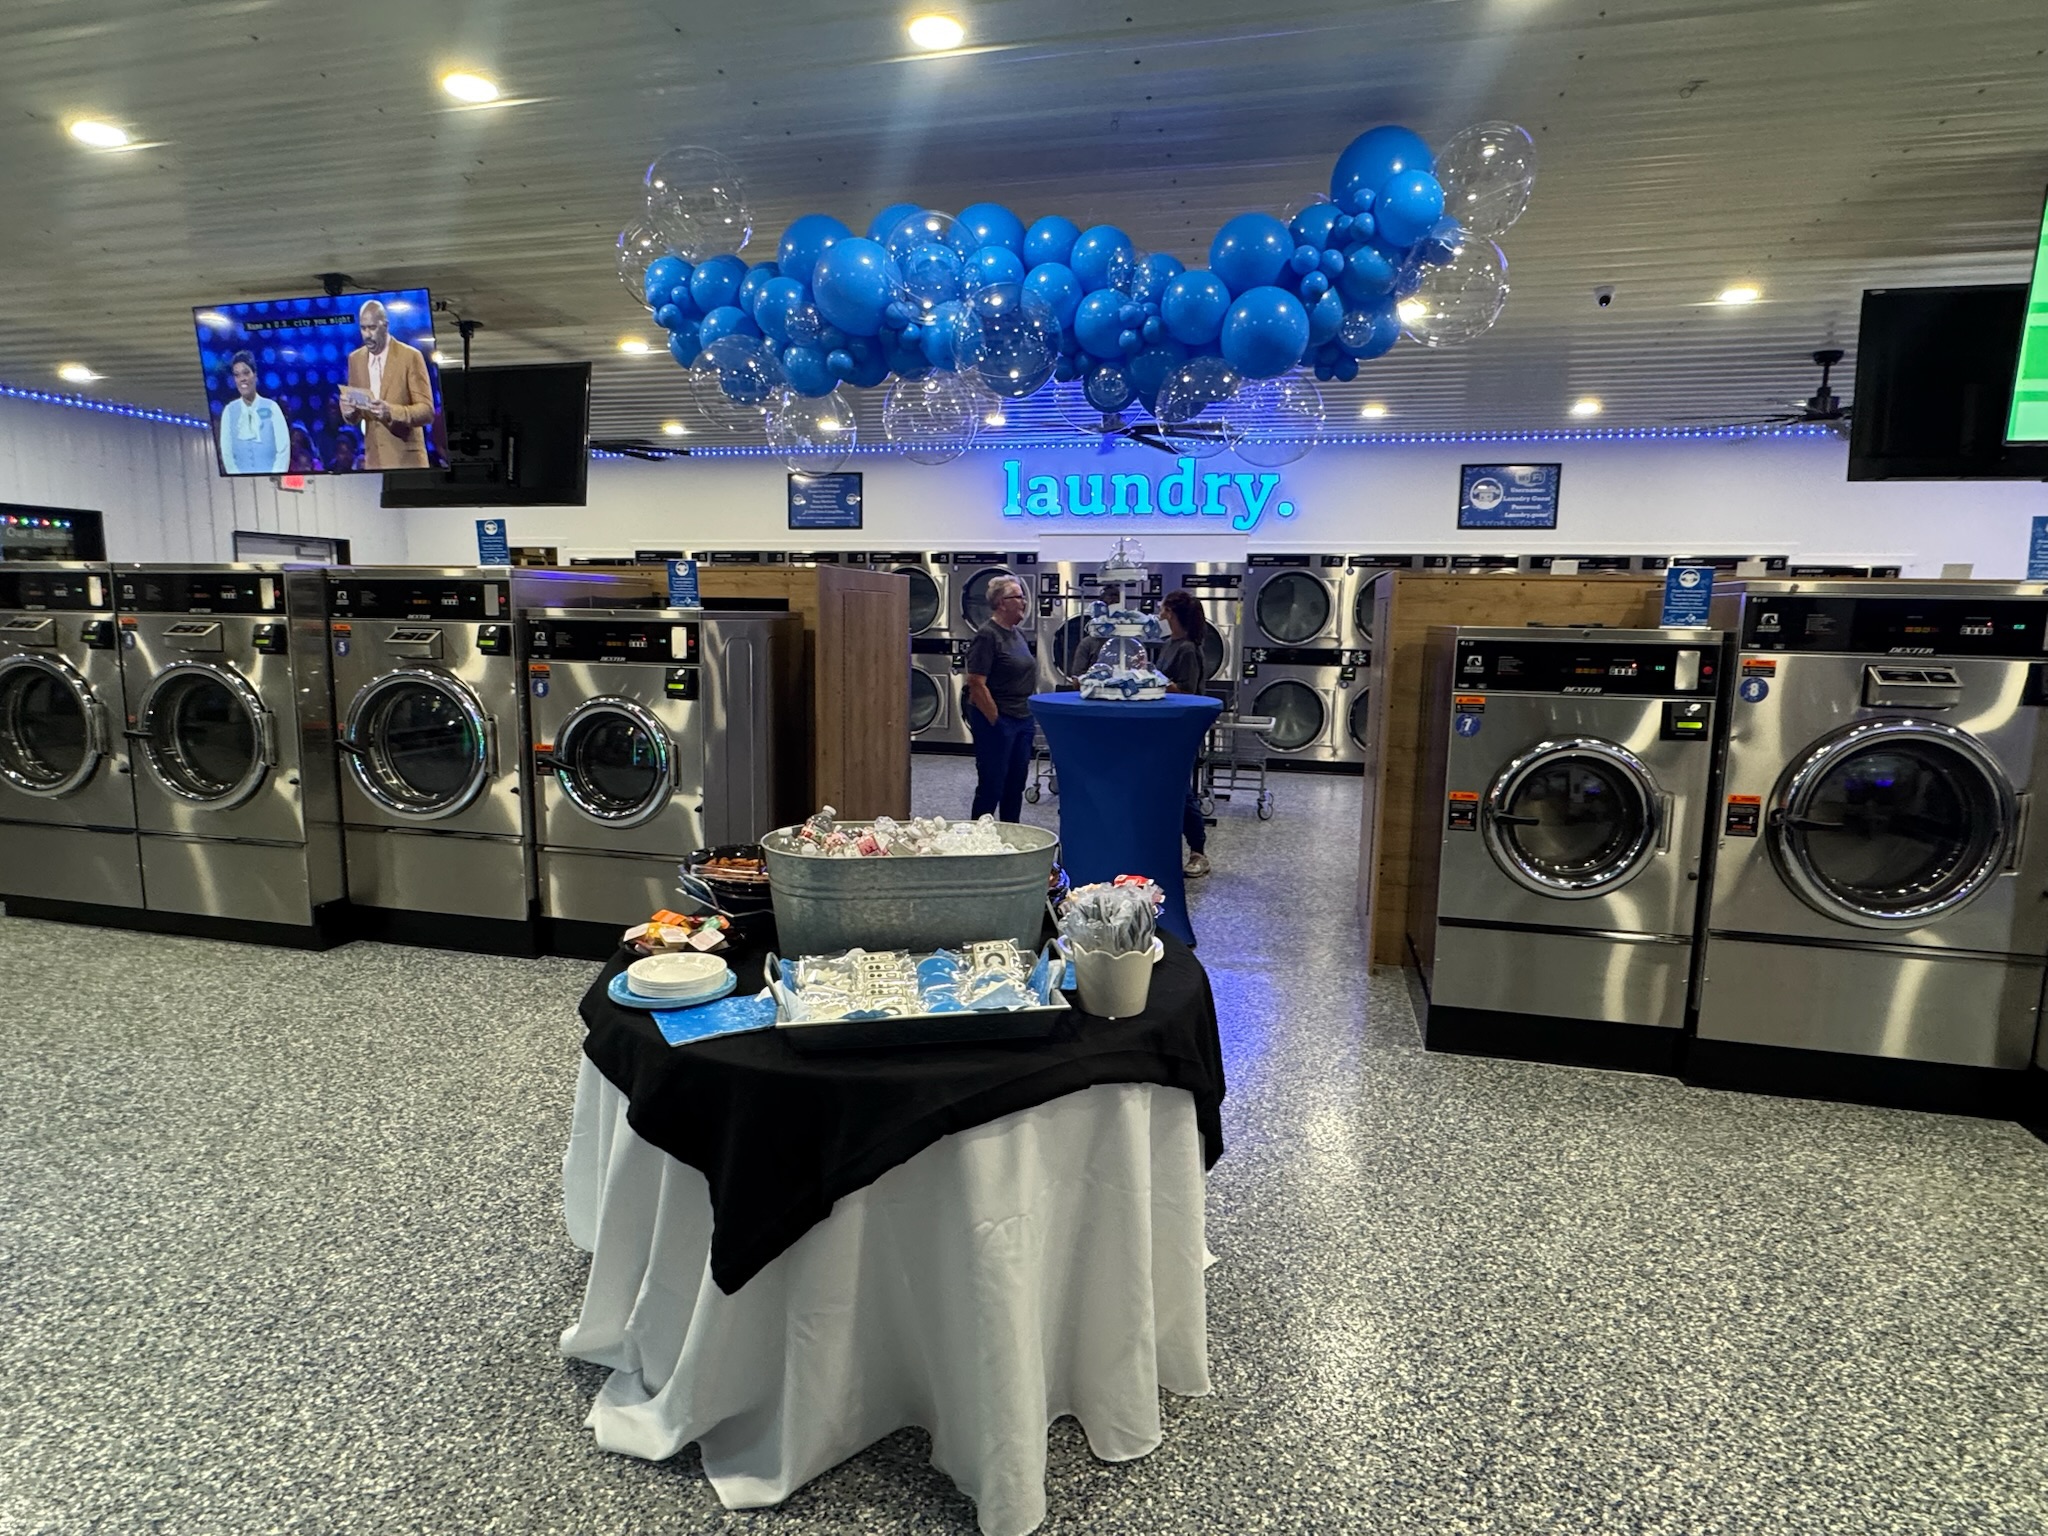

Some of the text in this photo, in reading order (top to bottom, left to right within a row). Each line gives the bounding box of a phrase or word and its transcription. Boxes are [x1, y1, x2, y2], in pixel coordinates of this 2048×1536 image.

[293, 319, 311, 327] city
[313, 318, 328, 326] you
[329, 316, 351, 324] might
[1002, 456, 1295, 531] laundry.
[1749, 682, 1759, 697] 8
[1464, 718, 1473, 731] 7
